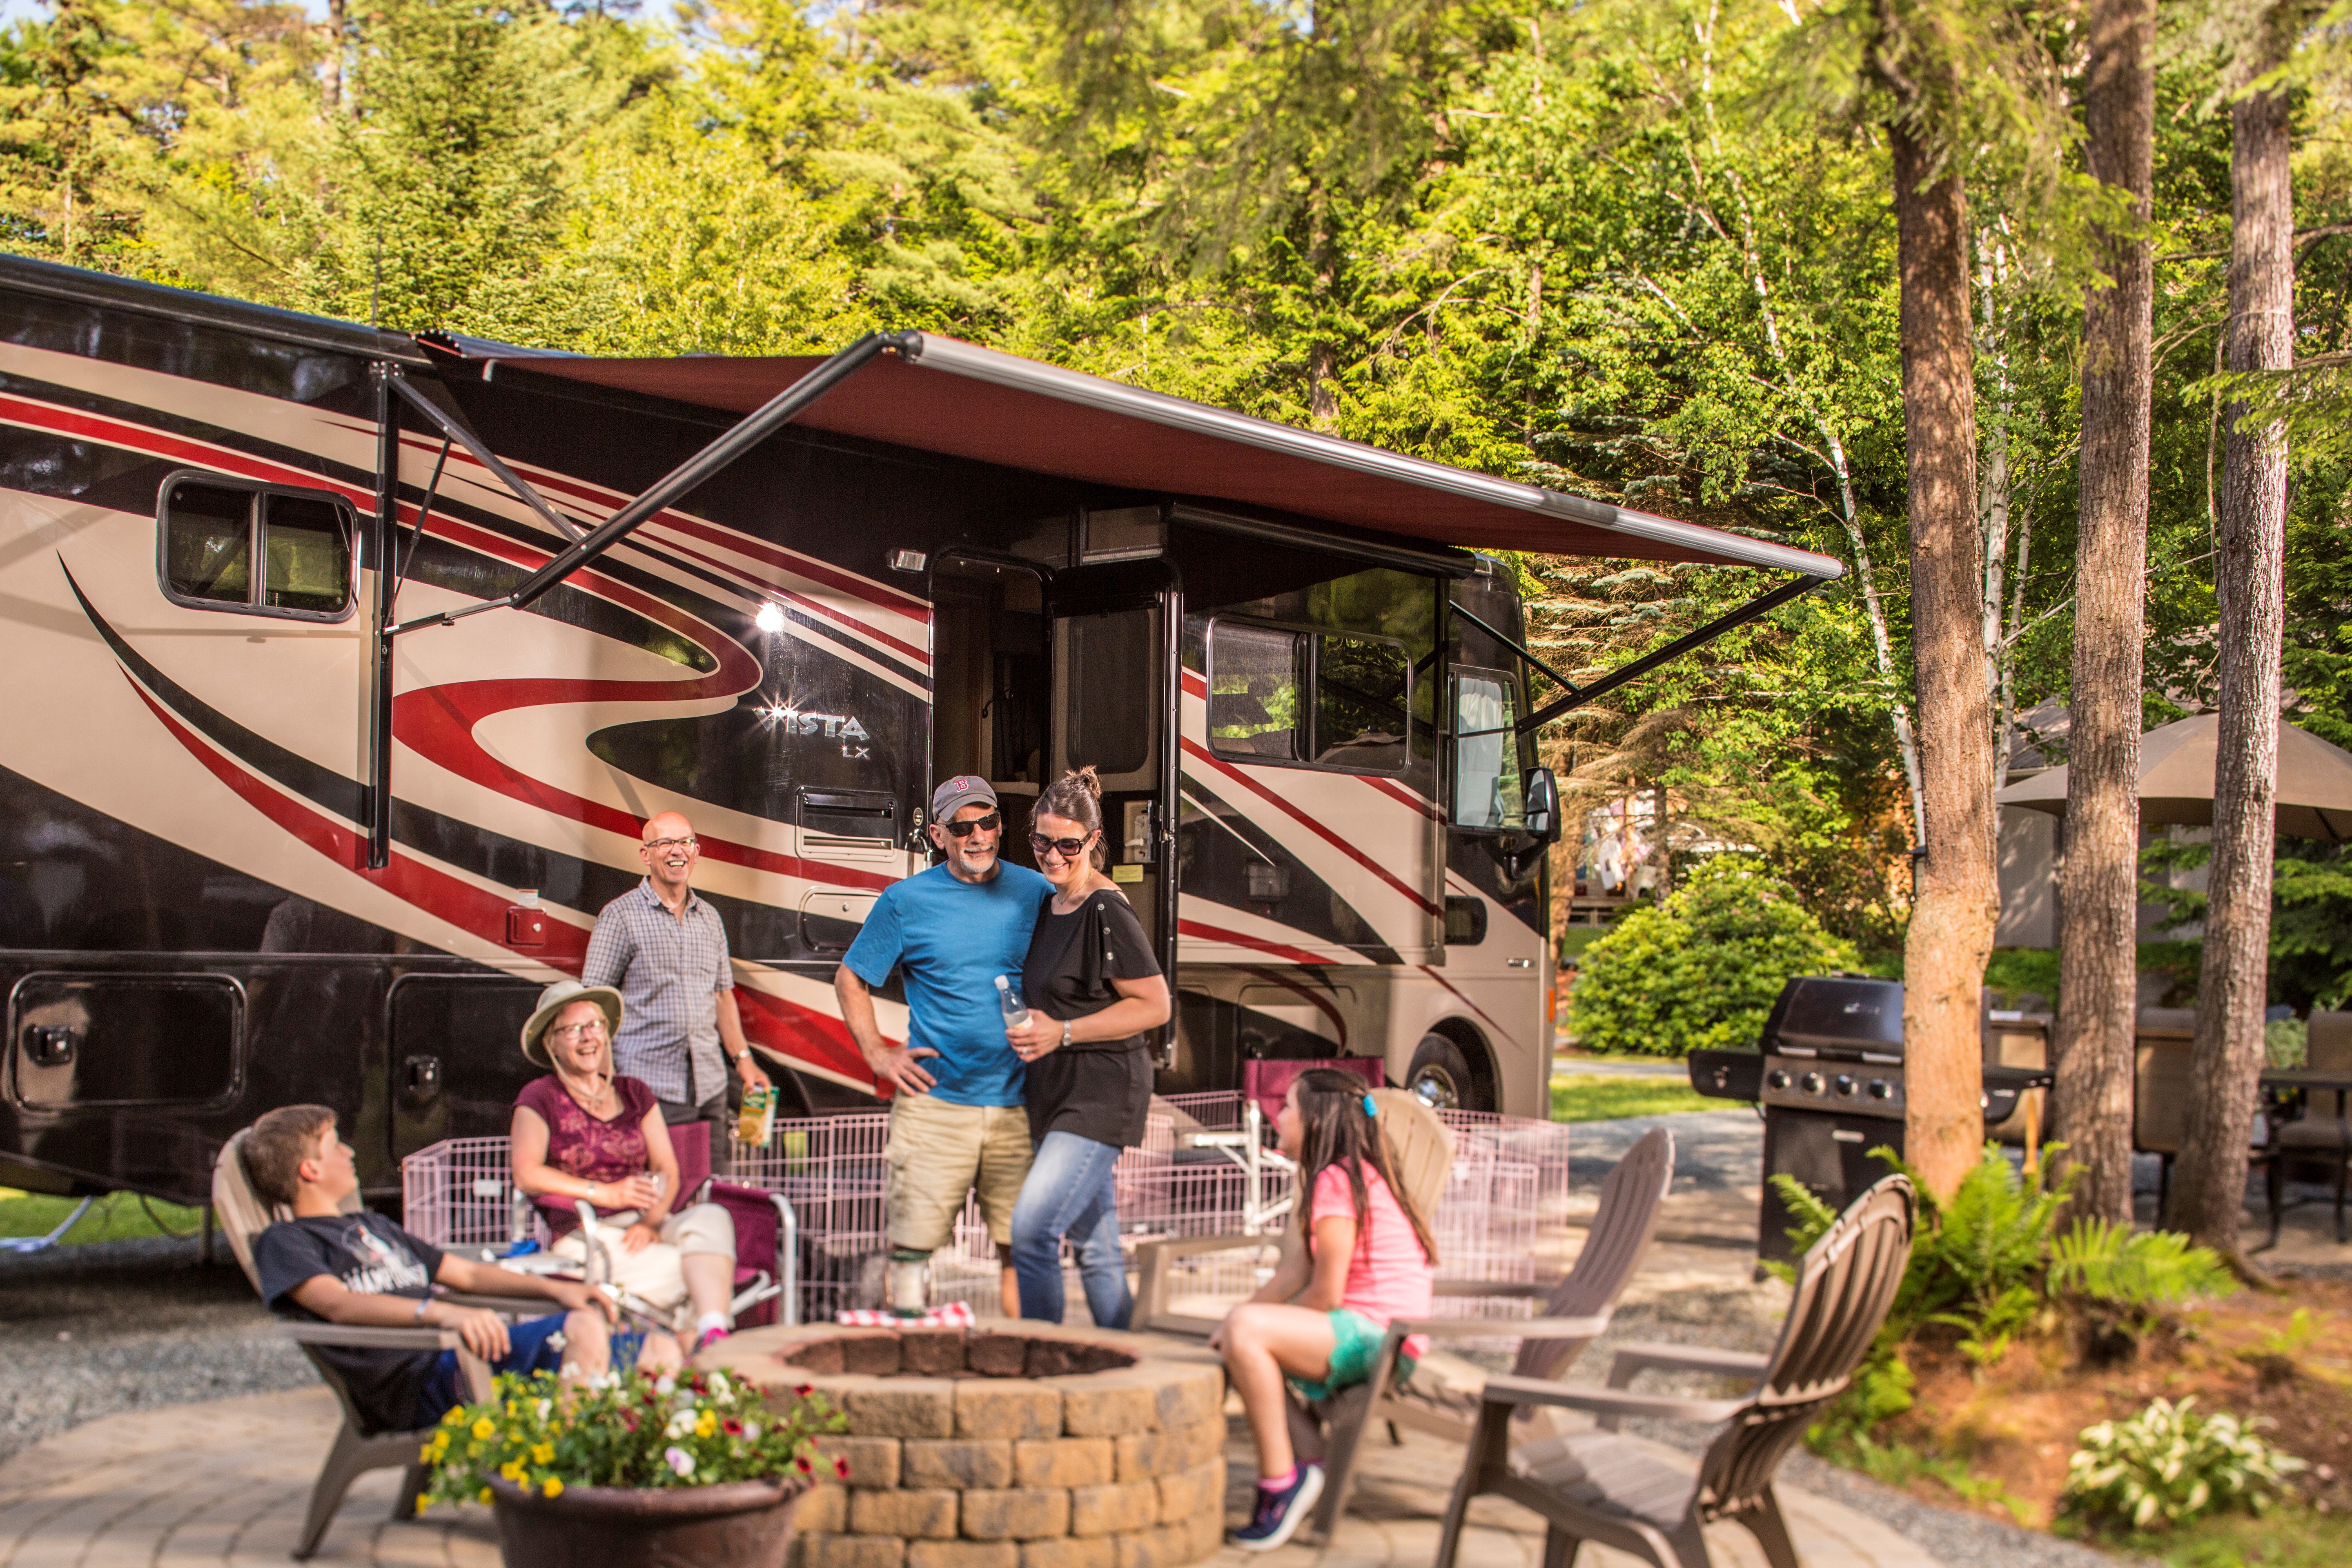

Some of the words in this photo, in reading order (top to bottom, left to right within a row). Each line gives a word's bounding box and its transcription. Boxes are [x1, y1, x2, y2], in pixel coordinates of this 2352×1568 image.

[752, 706, 869, 741] VISTA
[843, 744, 870, 760] LX
[954, 779, 969, 792] B
